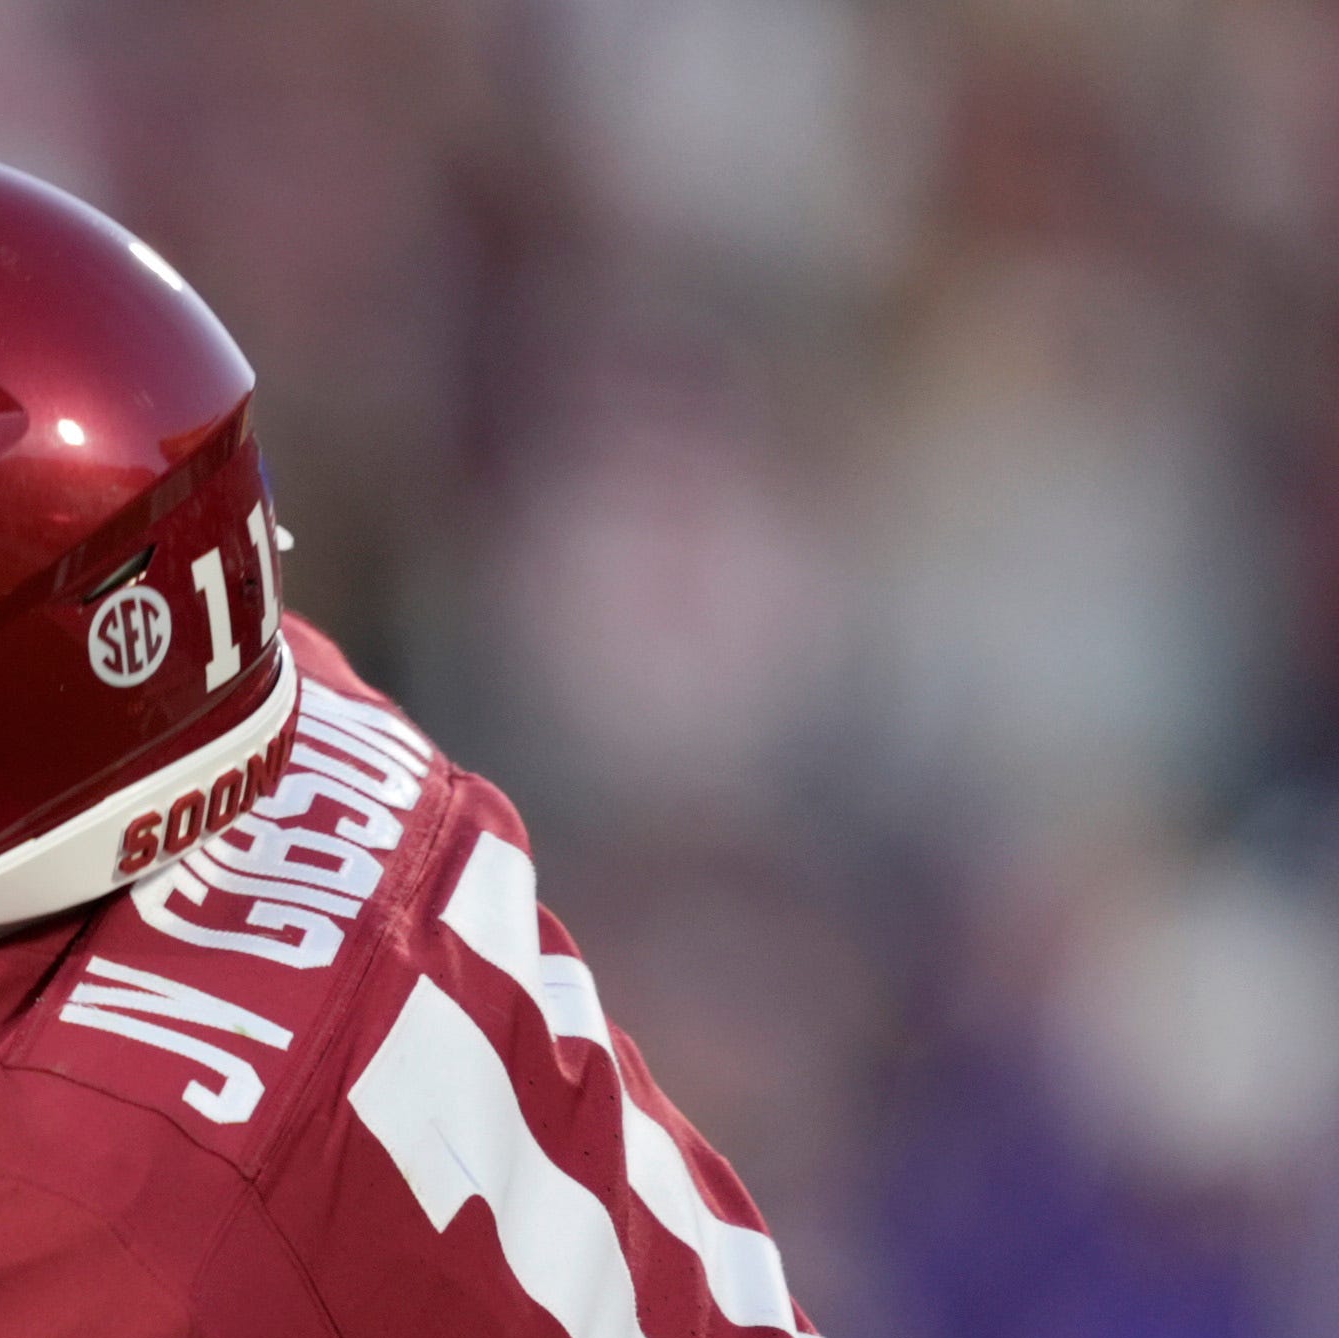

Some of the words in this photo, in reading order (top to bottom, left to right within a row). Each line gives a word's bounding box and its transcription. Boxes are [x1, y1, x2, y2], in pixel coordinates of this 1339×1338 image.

[96, 590, 164, 678] SEC
[130, 677, 433, 970] GIBSON
[59, 955, 295, 1124] JV
